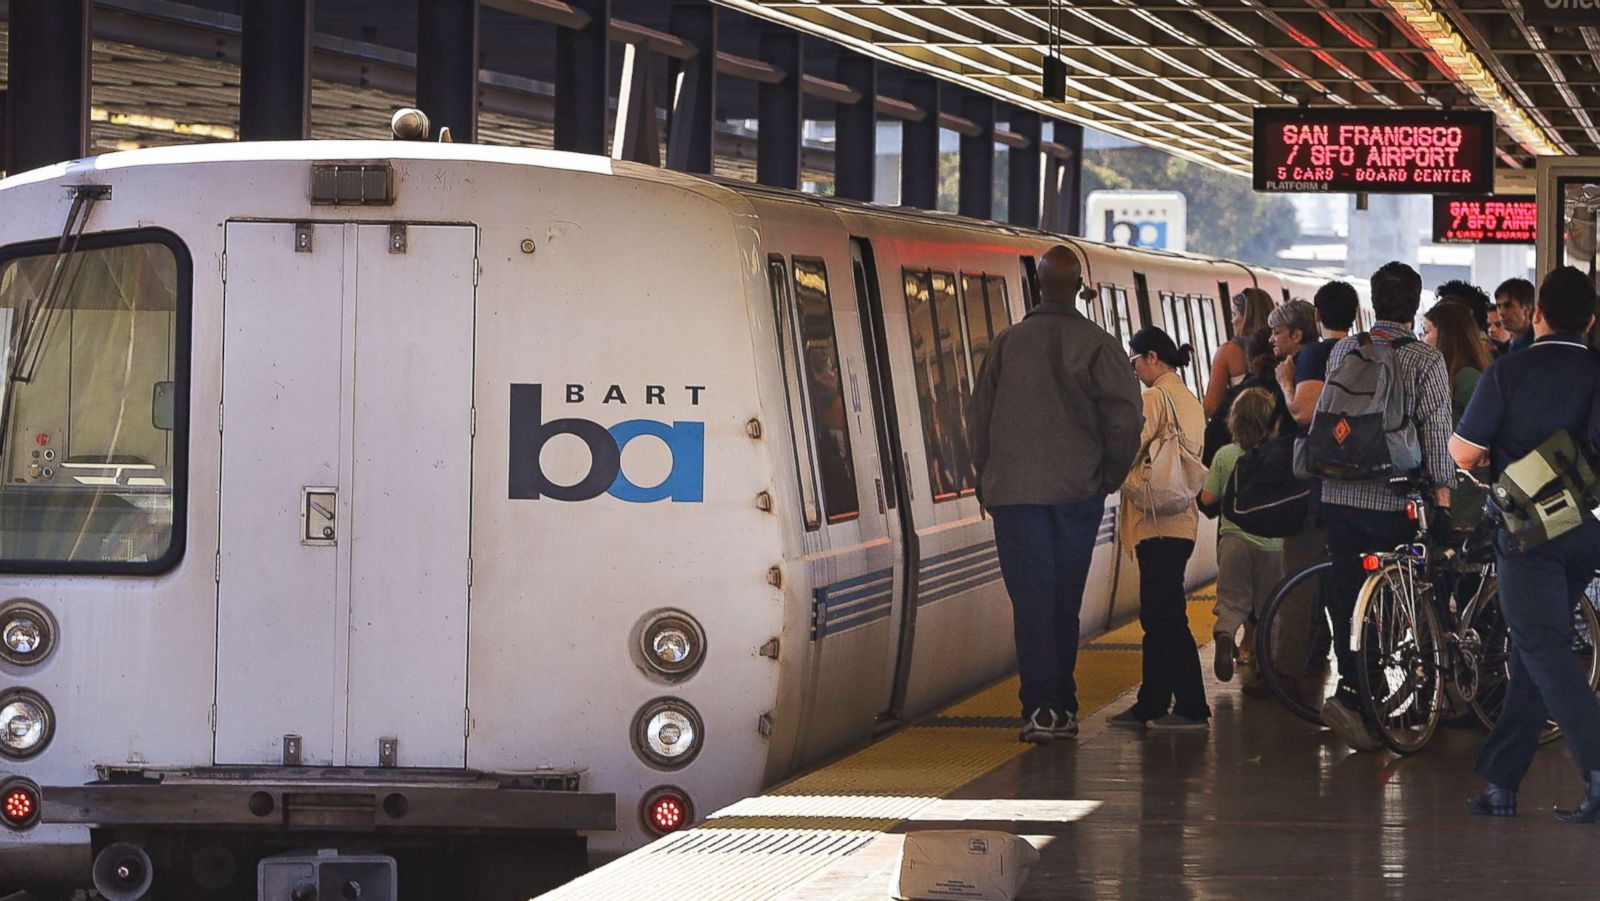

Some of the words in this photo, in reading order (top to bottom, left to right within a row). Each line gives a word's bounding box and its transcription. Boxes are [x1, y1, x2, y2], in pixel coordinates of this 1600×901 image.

[1283, 125, 1328, 144] SAN
[1340, 125, 1462, 146] FRANCISCO
[1310, 145, 1355, 166] SFO
[1366, 147, 1459, 167] AIRPORT
[1277, 166, 1287, 180] 5
[1293, 167, 1334, 180] CARS
[1355, 168, 1407, 182] BOARD
[1414, 169, 1472, 183] CENTER
[1266, 181, 1318, 190] PLATFORM
[1321, 182, 1328, 190] 4
[1450, 202, 1480, 216] SAN
[1467, 215, 1497, 230] SFO
[566, 383, 705, 405] BART
